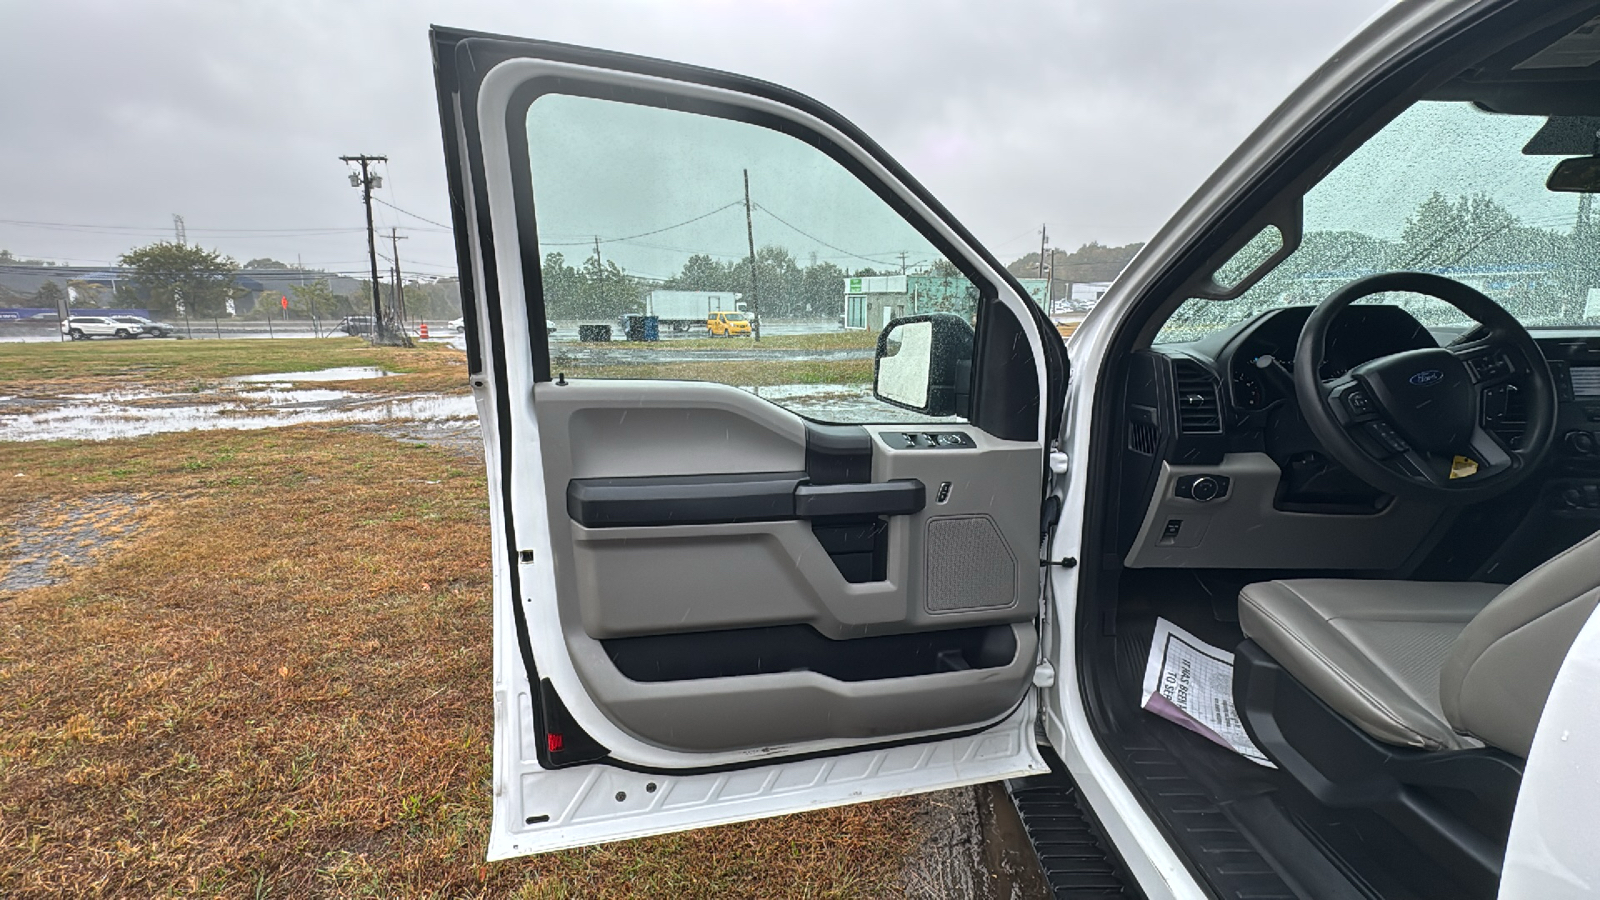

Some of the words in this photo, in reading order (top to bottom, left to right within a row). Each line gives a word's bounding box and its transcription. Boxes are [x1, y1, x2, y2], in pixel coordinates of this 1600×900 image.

[1181, 658, 1191, 668] IT
[1166, 671, 1177, 684] TO
[1180, 666, 1191, 685] HAS
[1177, 684, 1189, 704] BEEN
